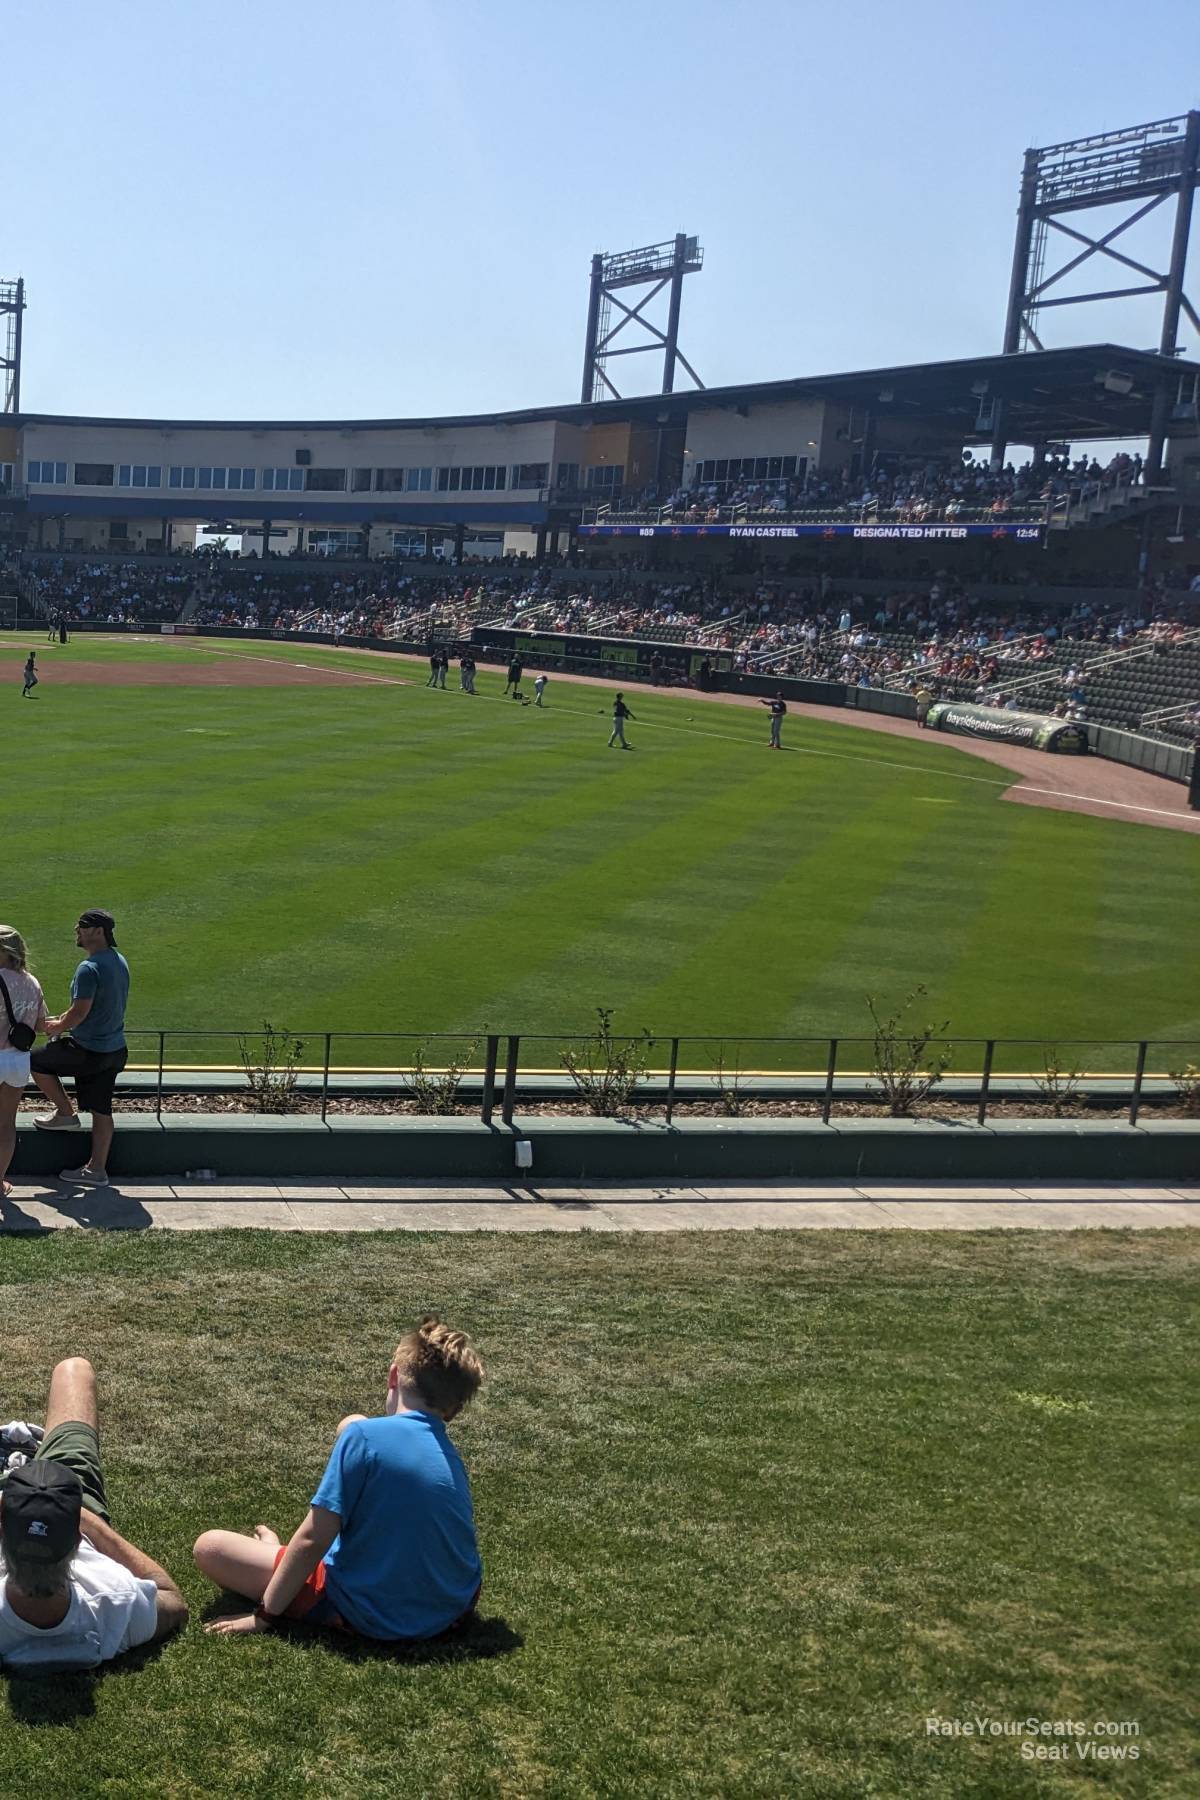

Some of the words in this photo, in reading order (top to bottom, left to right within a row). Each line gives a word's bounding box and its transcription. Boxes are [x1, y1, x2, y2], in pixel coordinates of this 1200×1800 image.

[639, 528, 654, 536] #89
[729, 528, 755, 537] RYAN
[755, 528, 799, 537] CASTEEL
[853, 528, 923, 538] DESIGNATED
[924, 528, 968, 538] HITTER
[1015, 529, 1039, 538] 12:54
